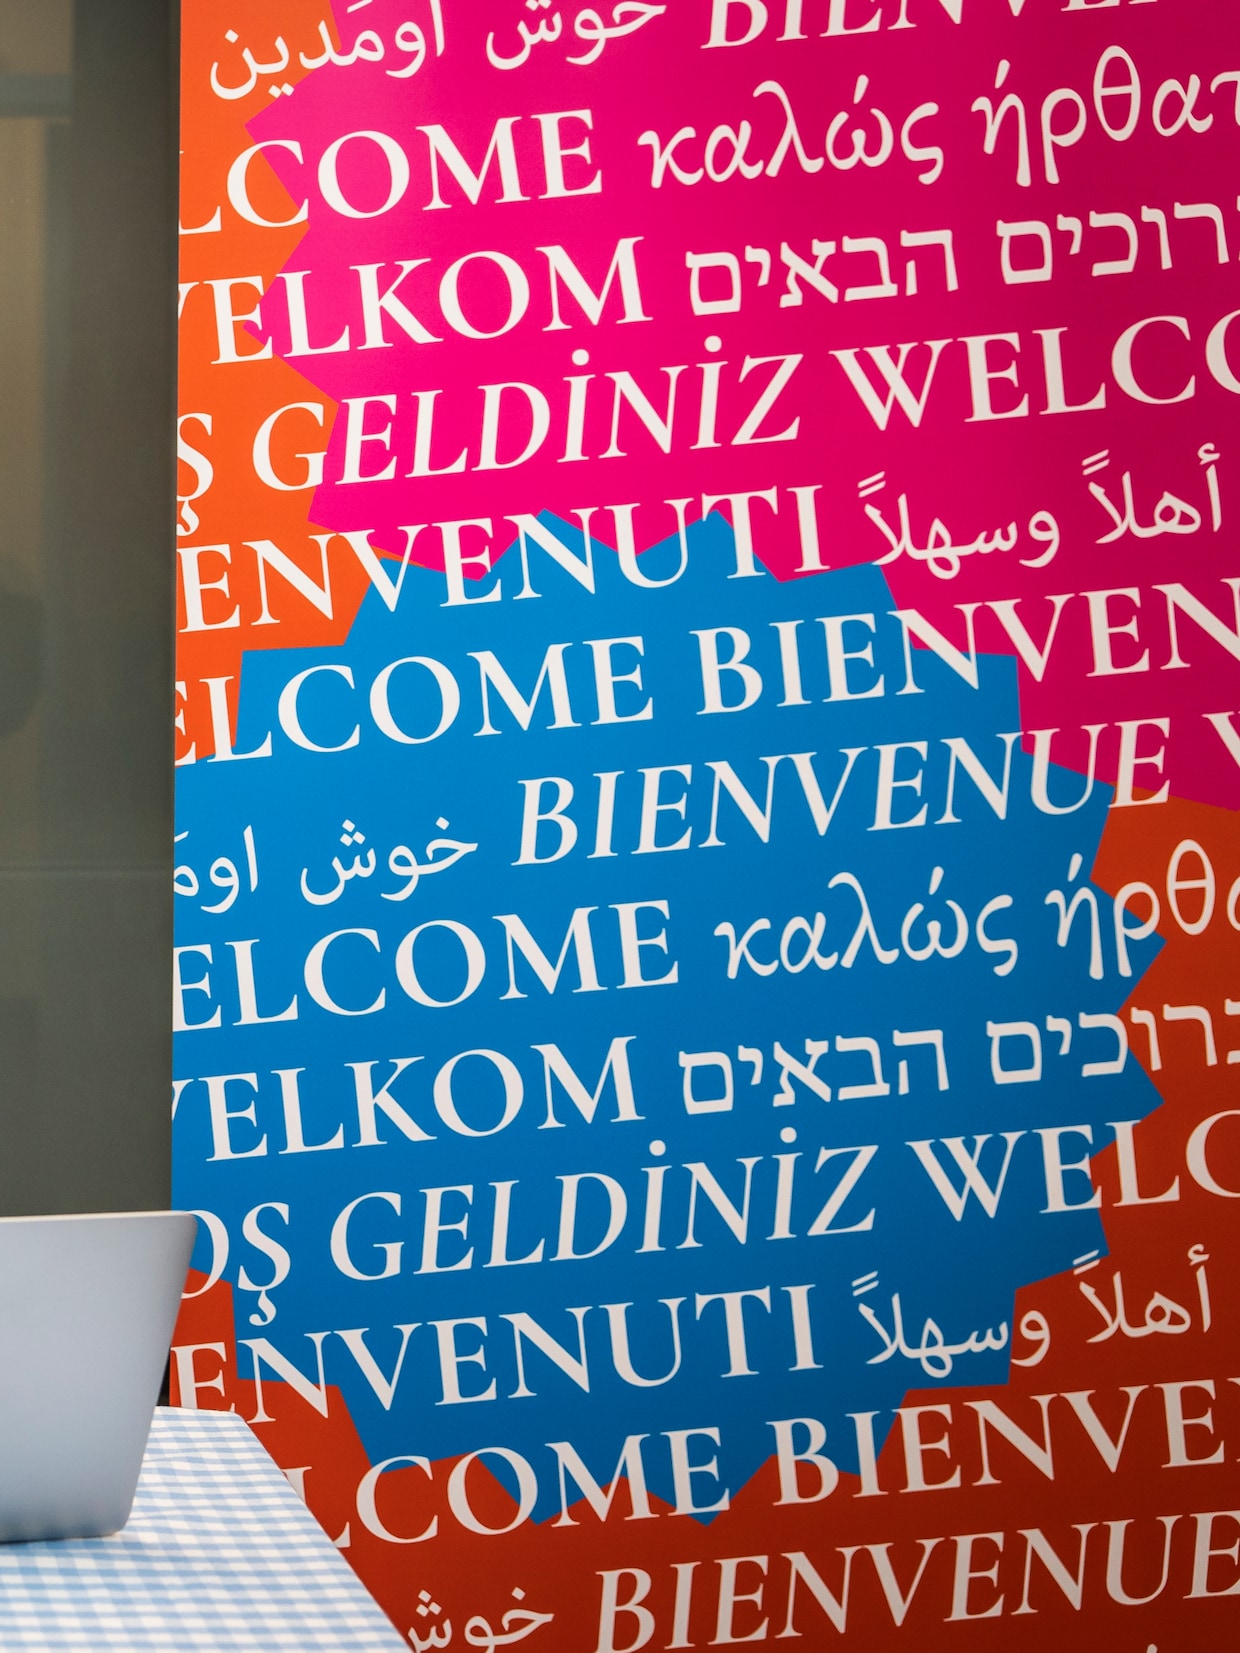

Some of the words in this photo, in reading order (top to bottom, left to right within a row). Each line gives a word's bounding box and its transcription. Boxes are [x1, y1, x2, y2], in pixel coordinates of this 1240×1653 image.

[638, 75, 944, 189] καλώς
[686, 230, 958, 316] הבאים
[253, 336, 803, 490] GELDİNİZ
[176, 486, 829, 633] ENVENUTI
[512, 717, 1170, 866] BIENVENUE
[301, 816, 478, 906] خوش
[714, 866, 1019, 979] καλώς
[679, 1030, 949, 1115] הבאים
[331, 1127, 879, 1281] GELDİNİZ
[597, 1511, 1240, 1653] BIENVENUE
